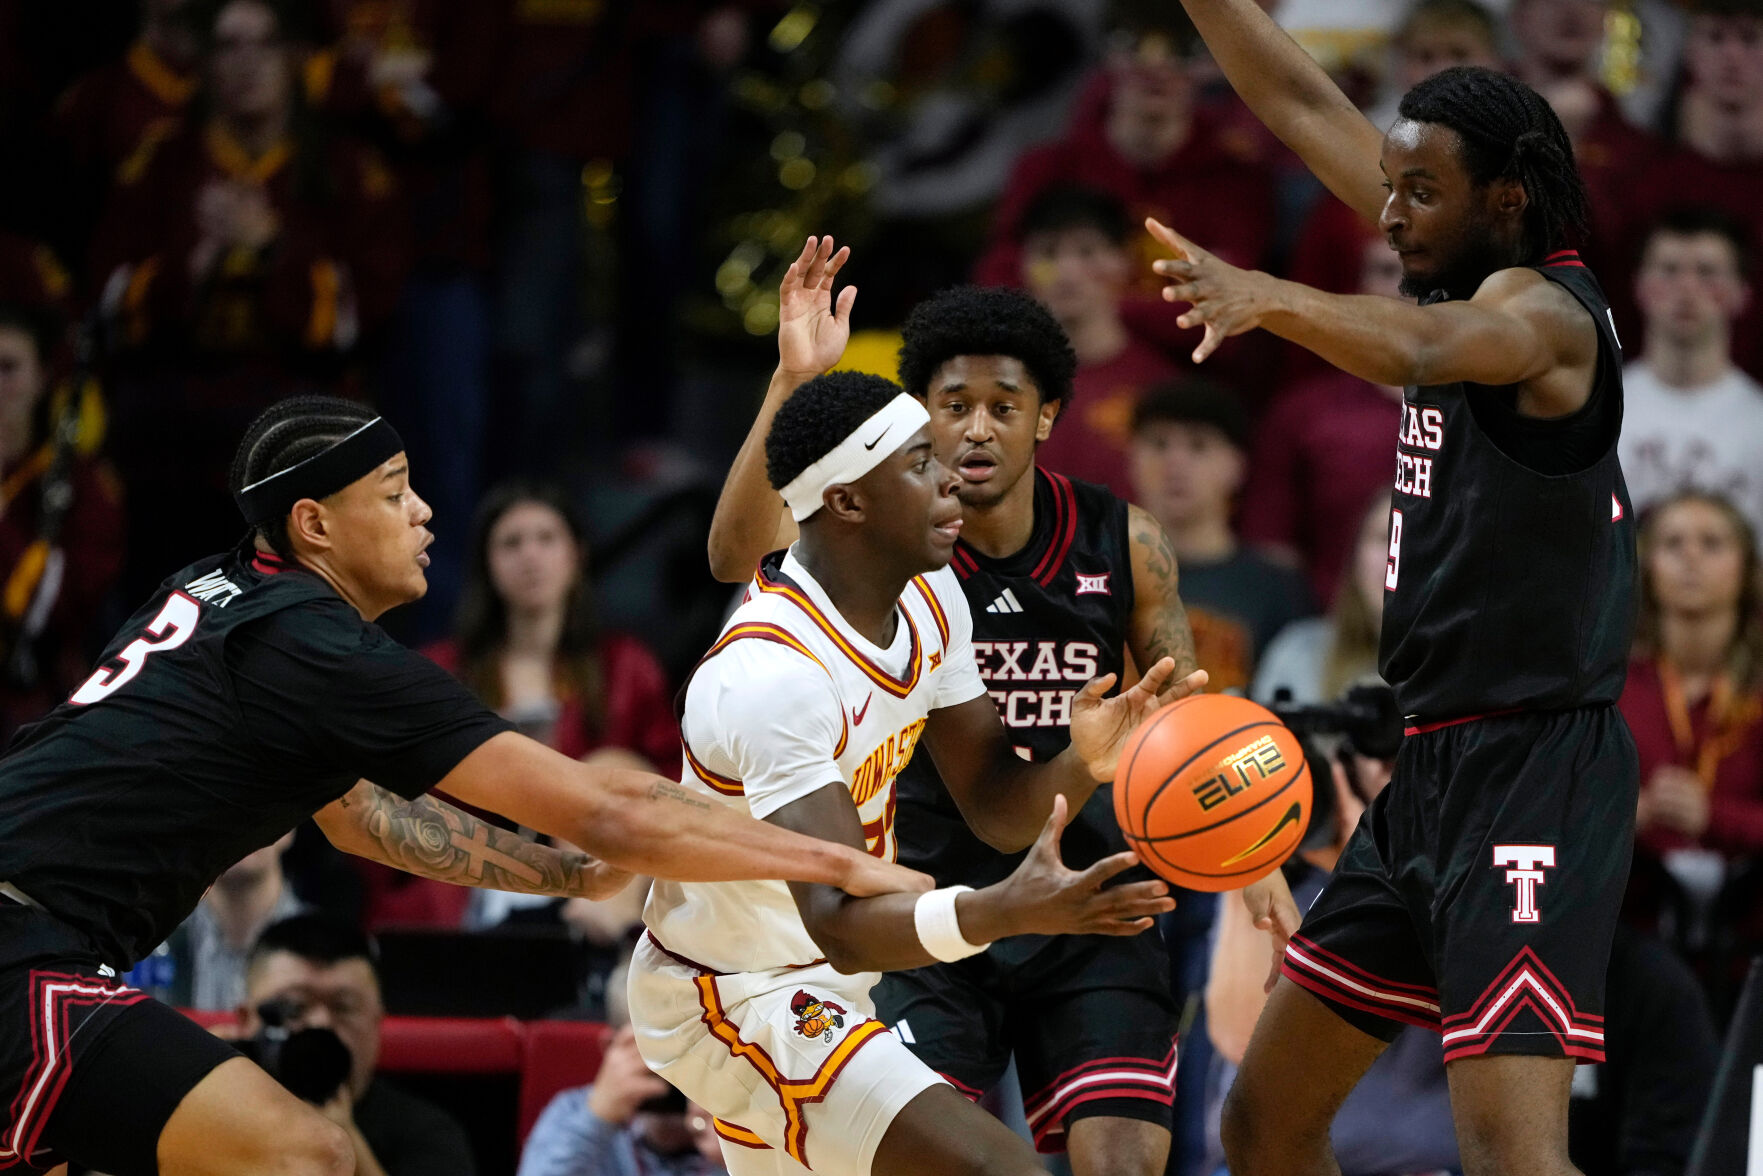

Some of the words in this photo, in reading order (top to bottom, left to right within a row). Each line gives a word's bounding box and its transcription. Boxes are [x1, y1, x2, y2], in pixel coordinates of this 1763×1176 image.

[1394, 450, 1432, 498] ECH
[67, 589, 200, 706] 3
[972, 640, 1099, 682] EXAS
[850, 733, 896, 808] IOWA
[1192, 741, 1287, 813] ELITE
